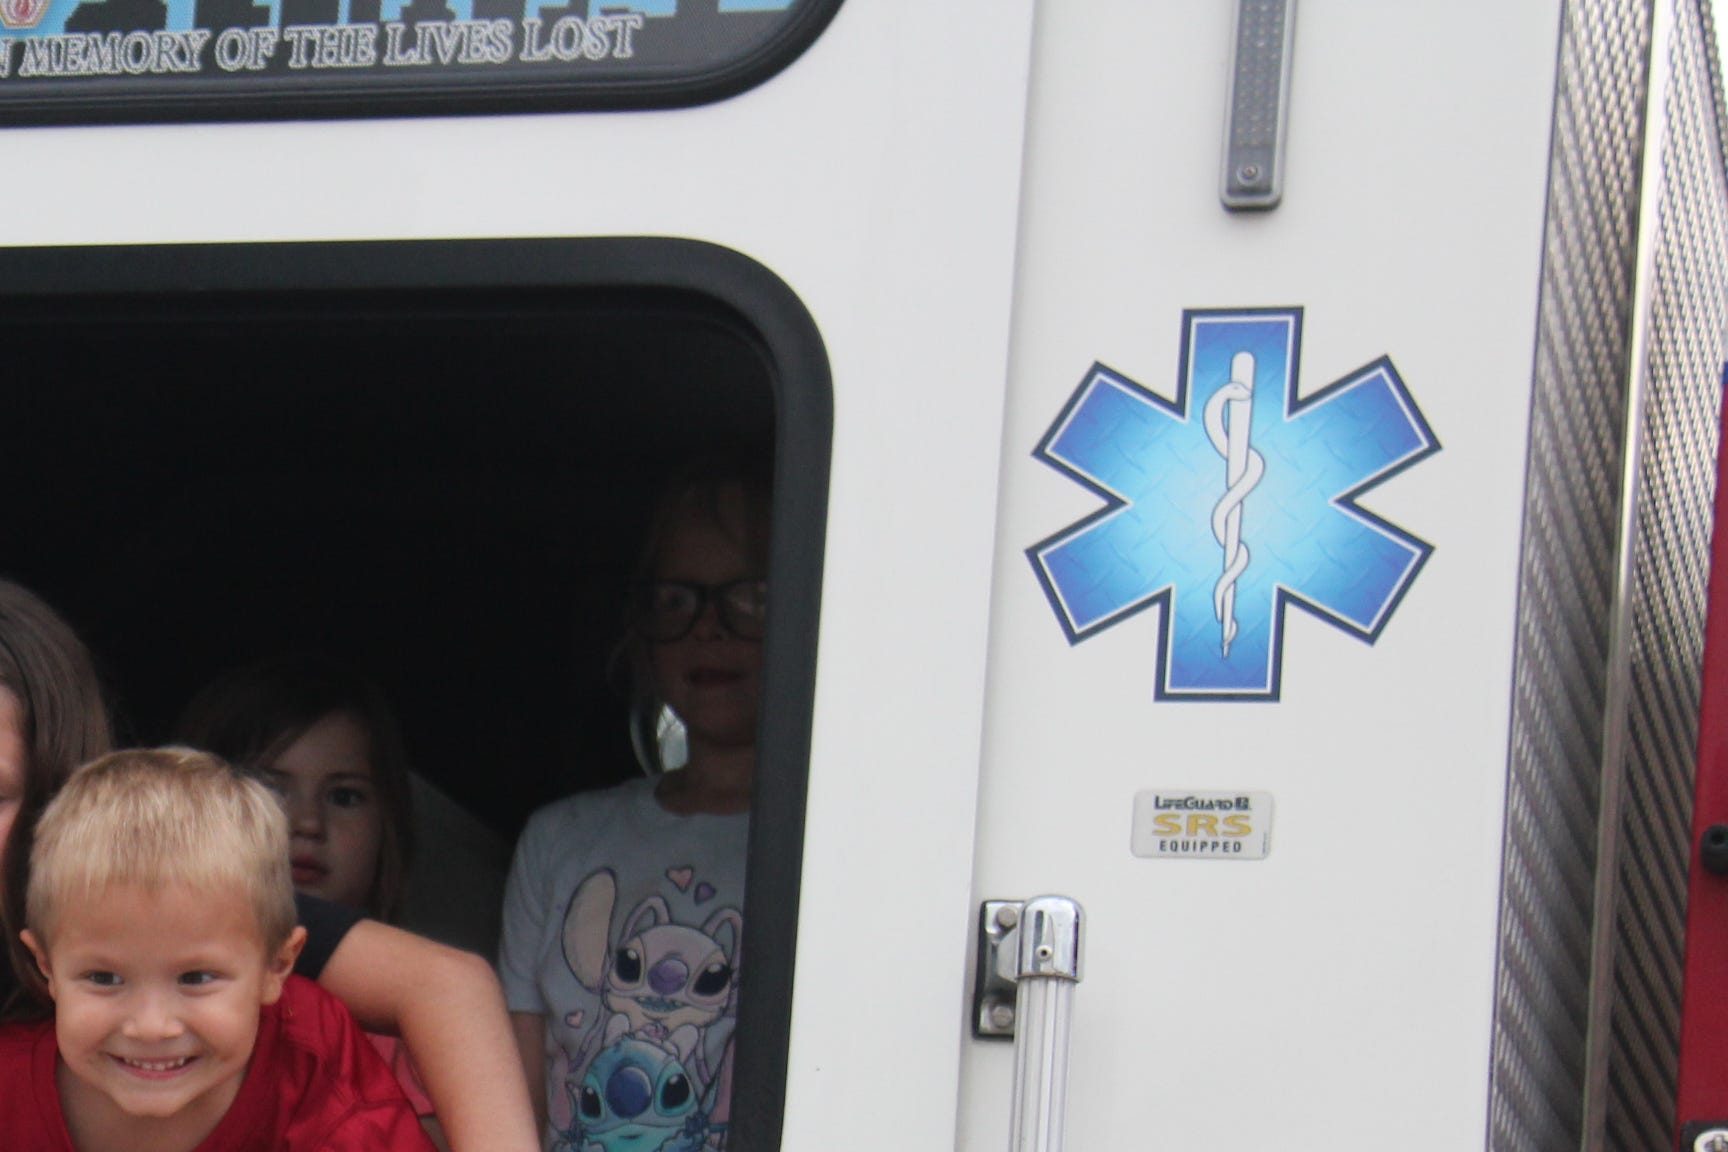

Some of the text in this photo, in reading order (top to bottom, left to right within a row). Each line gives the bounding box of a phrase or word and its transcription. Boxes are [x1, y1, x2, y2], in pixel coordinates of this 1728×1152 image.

[18, 31, 210, 78] MEMORY
[215, 27, 278, 72] OF
[283, 23, 377, 69] THE
[383, 18, 513, 65] LIVES
[519, 15, 643, 61] LOST
[1152, 813, 1252, 837] SRS
[1159, 840, 1242, 853] EQUIPPED
